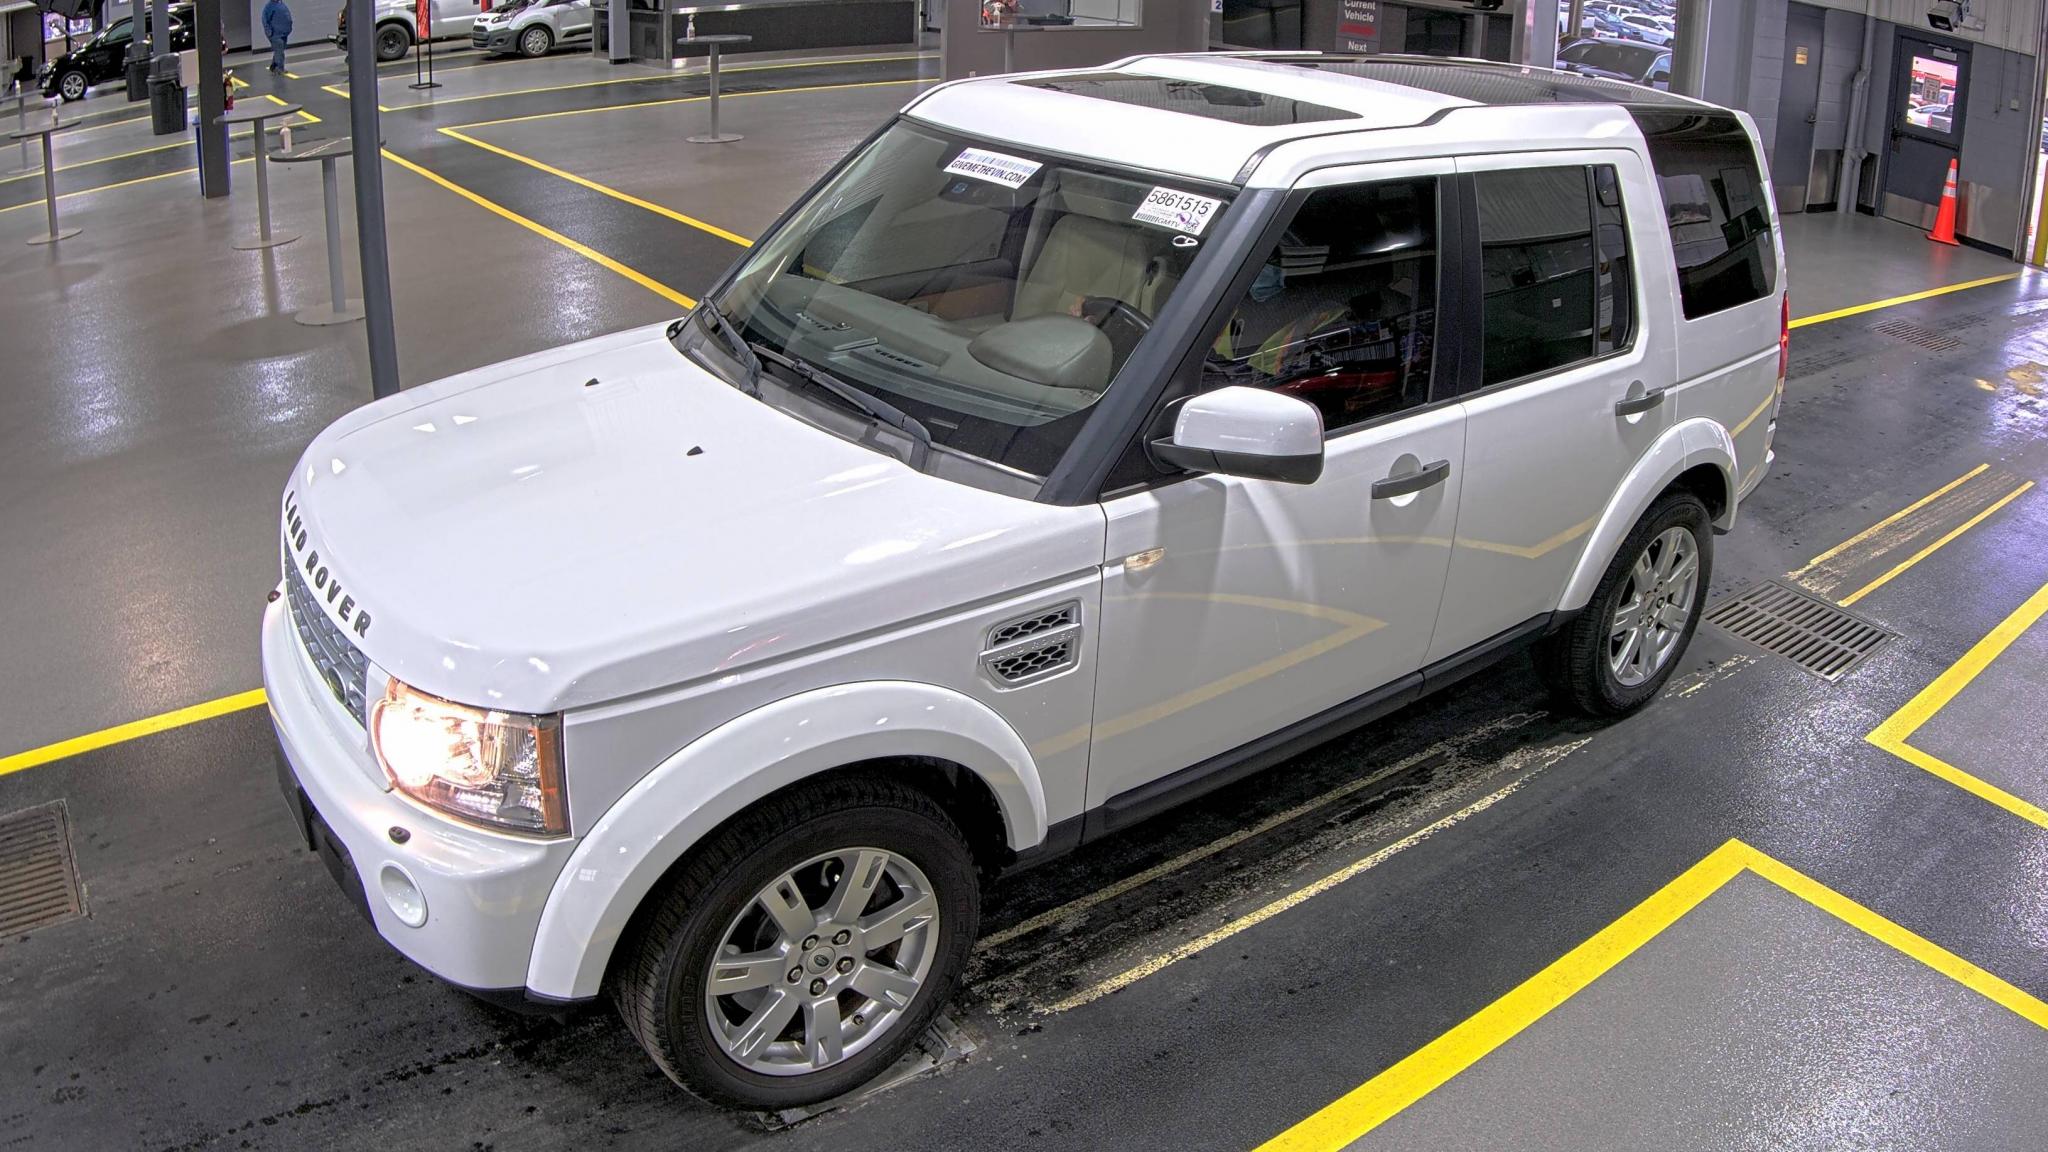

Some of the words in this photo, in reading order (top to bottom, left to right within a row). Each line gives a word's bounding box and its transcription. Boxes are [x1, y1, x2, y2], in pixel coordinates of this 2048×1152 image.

[1215, 0, 1222, 10] 2
[1344, 0, 1376, 10] Current
[1344, 10, 1375, 22] Vehicle
[1348, 40, 1367, 52] Next
[951, 160, 1026, 183] GIVEMETHEVIN.COM
[1147, 190, 1212, 215] 5861515
[284, 490, 308, 552] LAND
[305, 550, 372, 639] ROVER
